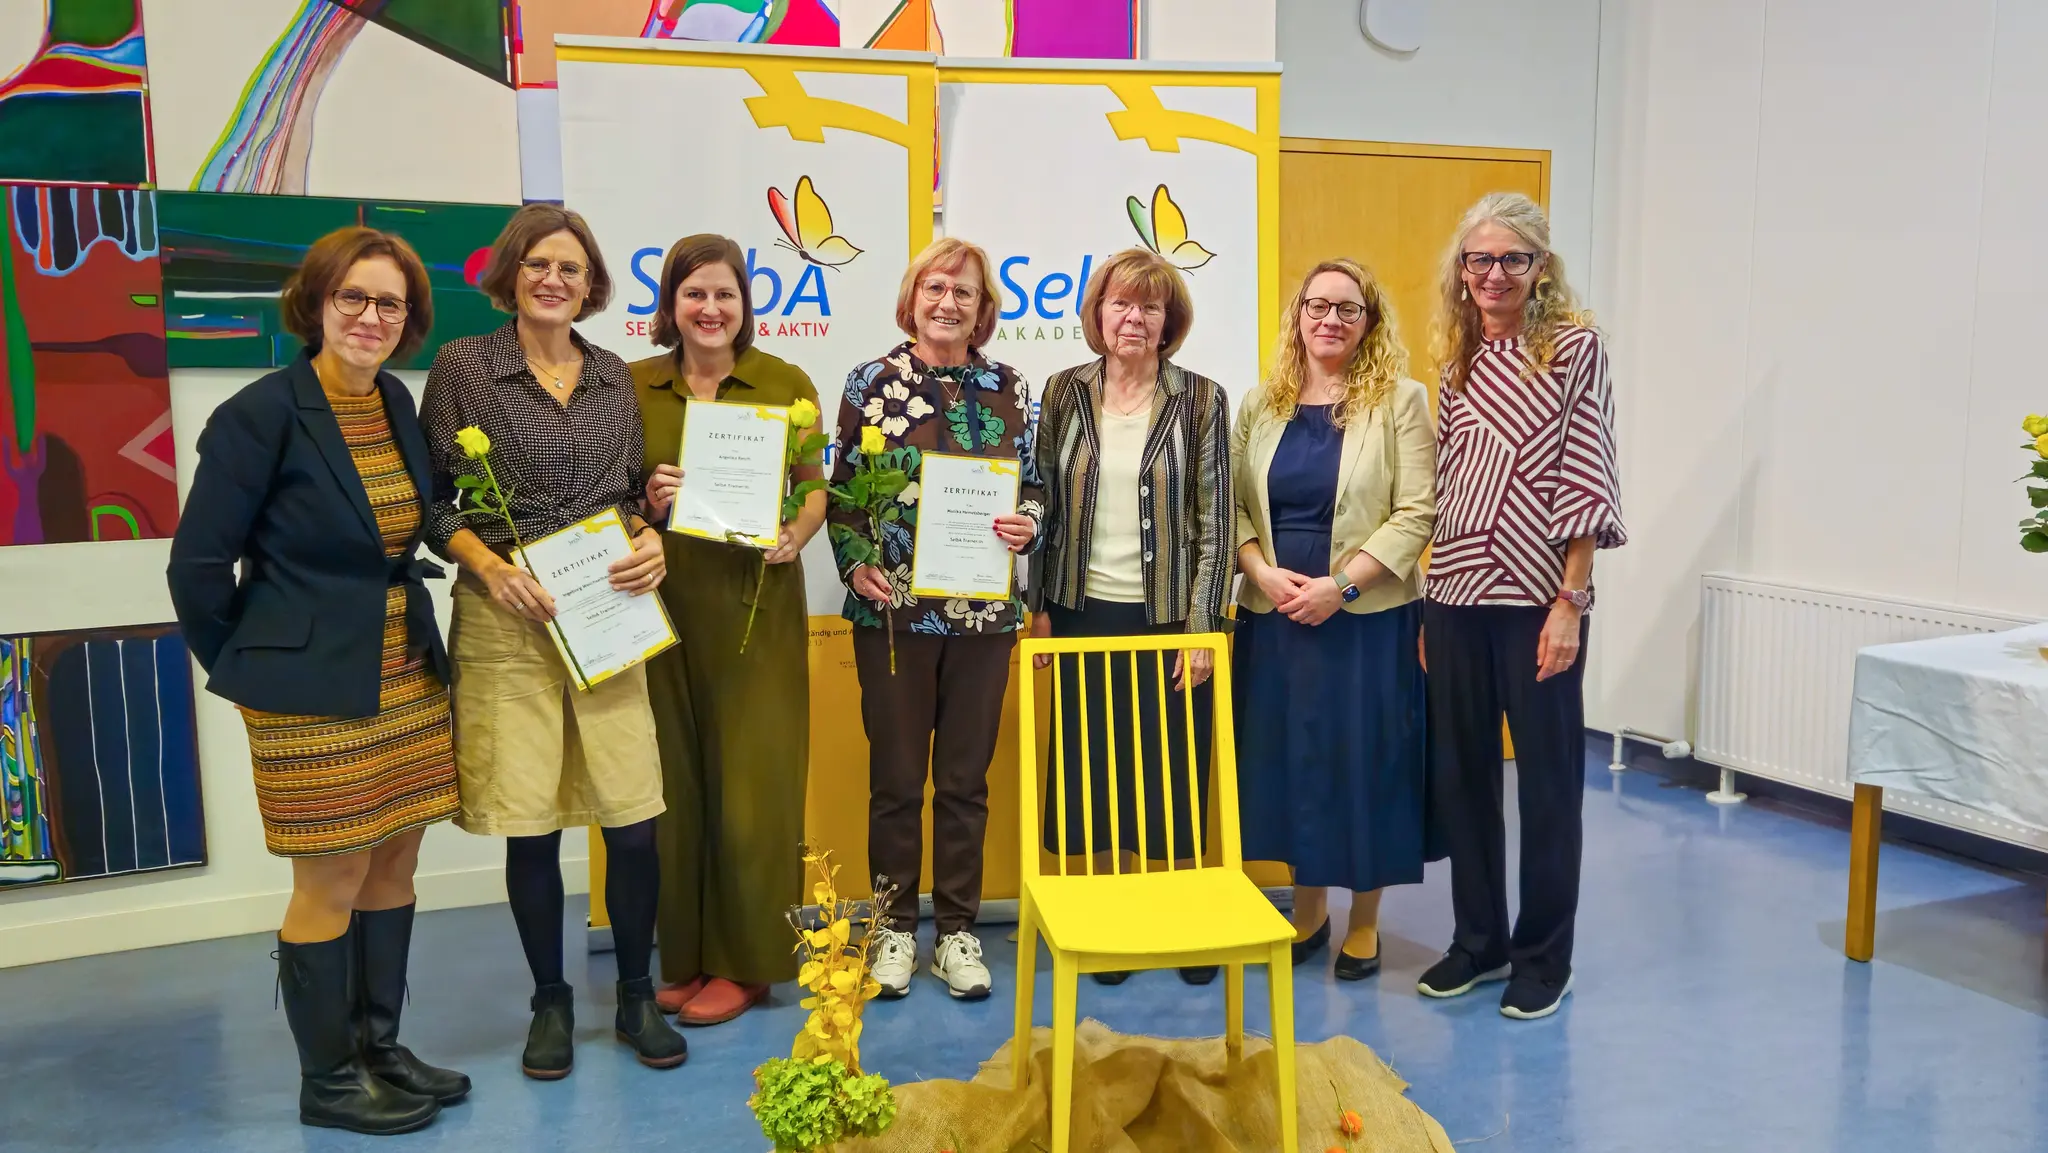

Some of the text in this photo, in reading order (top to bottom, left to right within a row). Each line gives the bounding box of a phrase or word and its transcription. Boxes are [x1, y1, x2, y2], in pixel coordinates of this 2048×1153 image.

[627, 247, 831, 316] SbA
[998, 255, 1093, 320] Sel
[758, 322, 770, 337] &
[777, 322, 829, 337] AKTIV
[997, 326, 1082, 340] AKADE
[709, 432, 765, 442] ZERTIFIKAT
[944, 486, 997, 496] ZERTIFIKAT
[551, 548, 609, 578] ZERTIFIKAT
